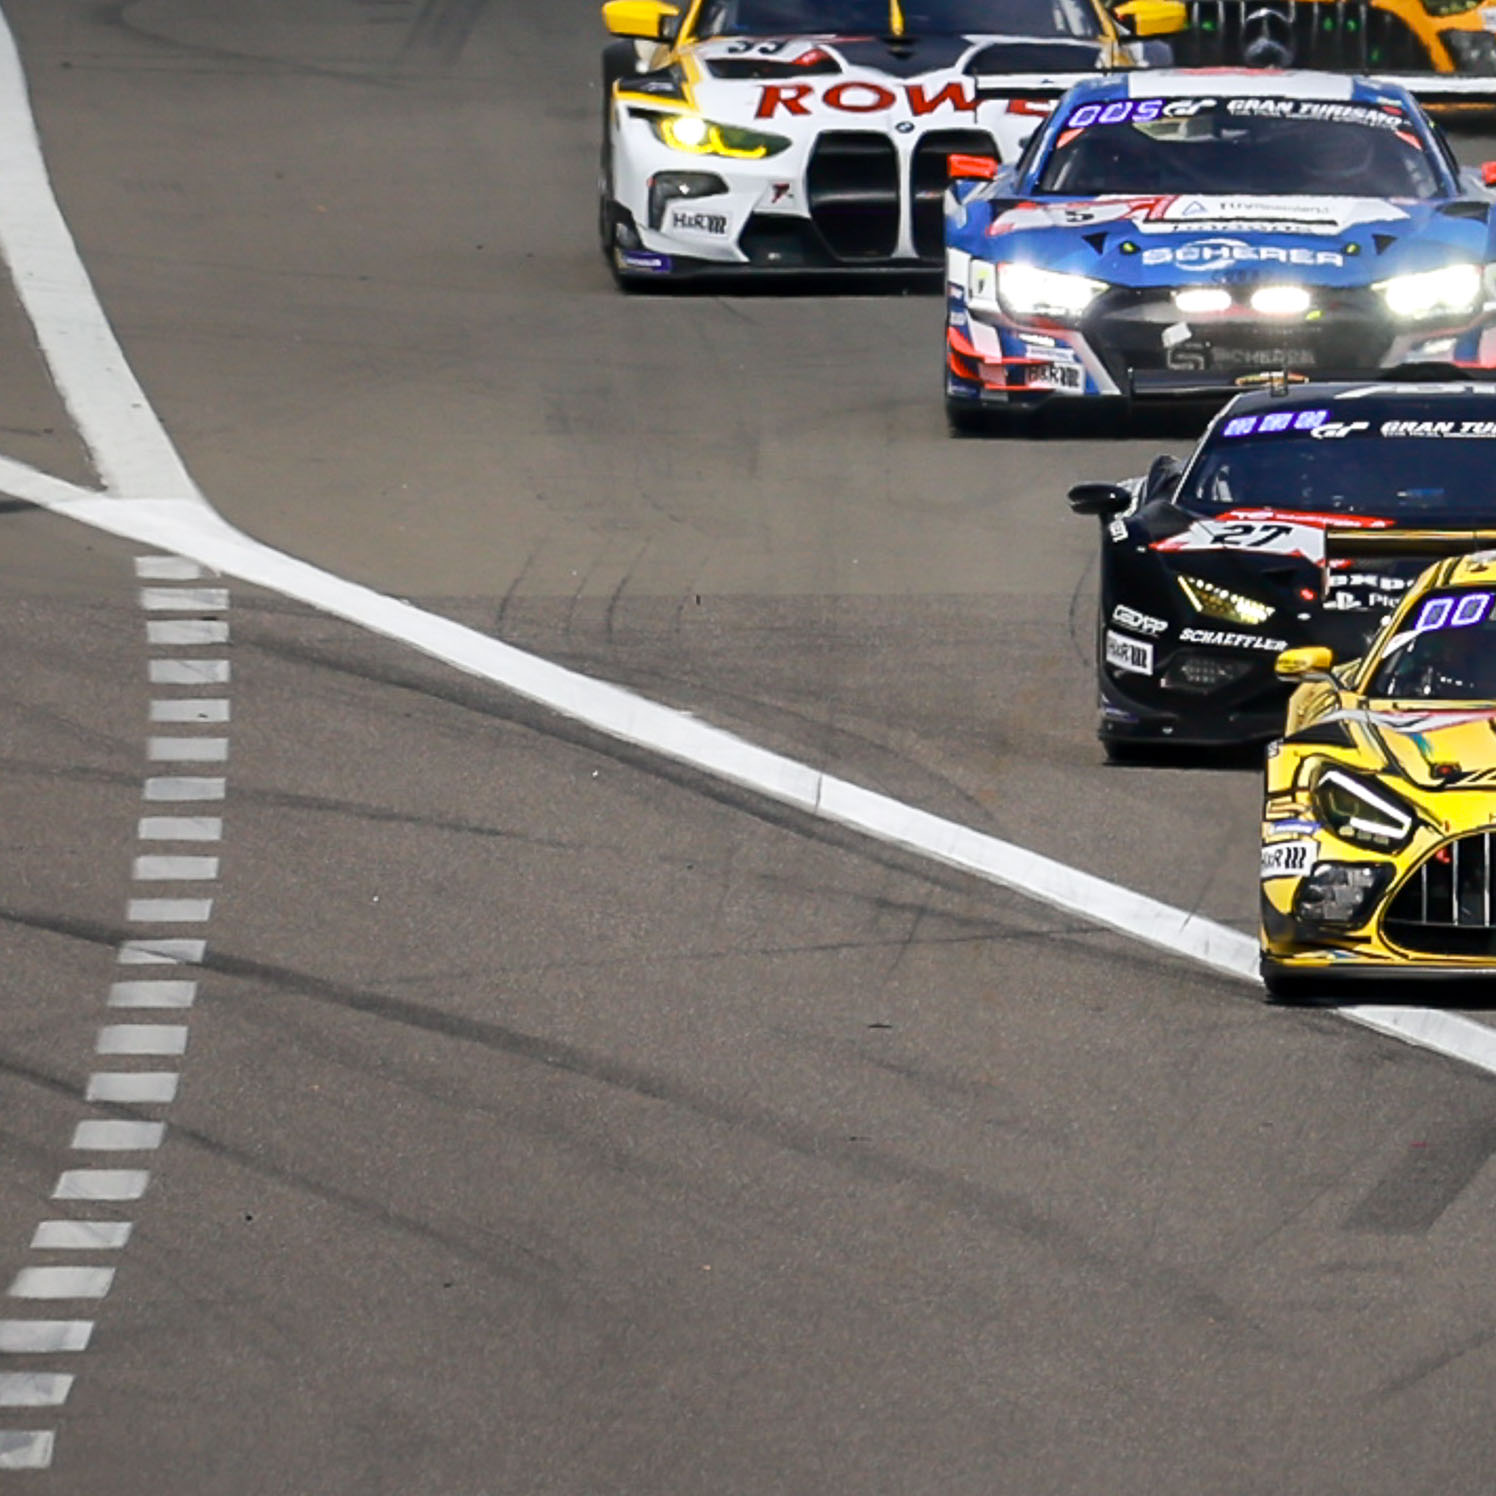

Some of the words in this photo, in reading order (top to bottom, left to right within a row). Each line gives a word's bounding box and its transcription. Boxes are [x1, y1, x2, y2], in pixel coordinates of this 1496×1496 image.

[1226, 99, 1294, 114] GRAN
[1299, 101, 1402, 126] TURISMO
[1141, 246, 1344, 267] SCHERER
[1380, 421, 1454, 435] GRAN
[1210, 524, 1293, 548] 27
[1178, 627, 1289, 651] SCHAEFFLER
